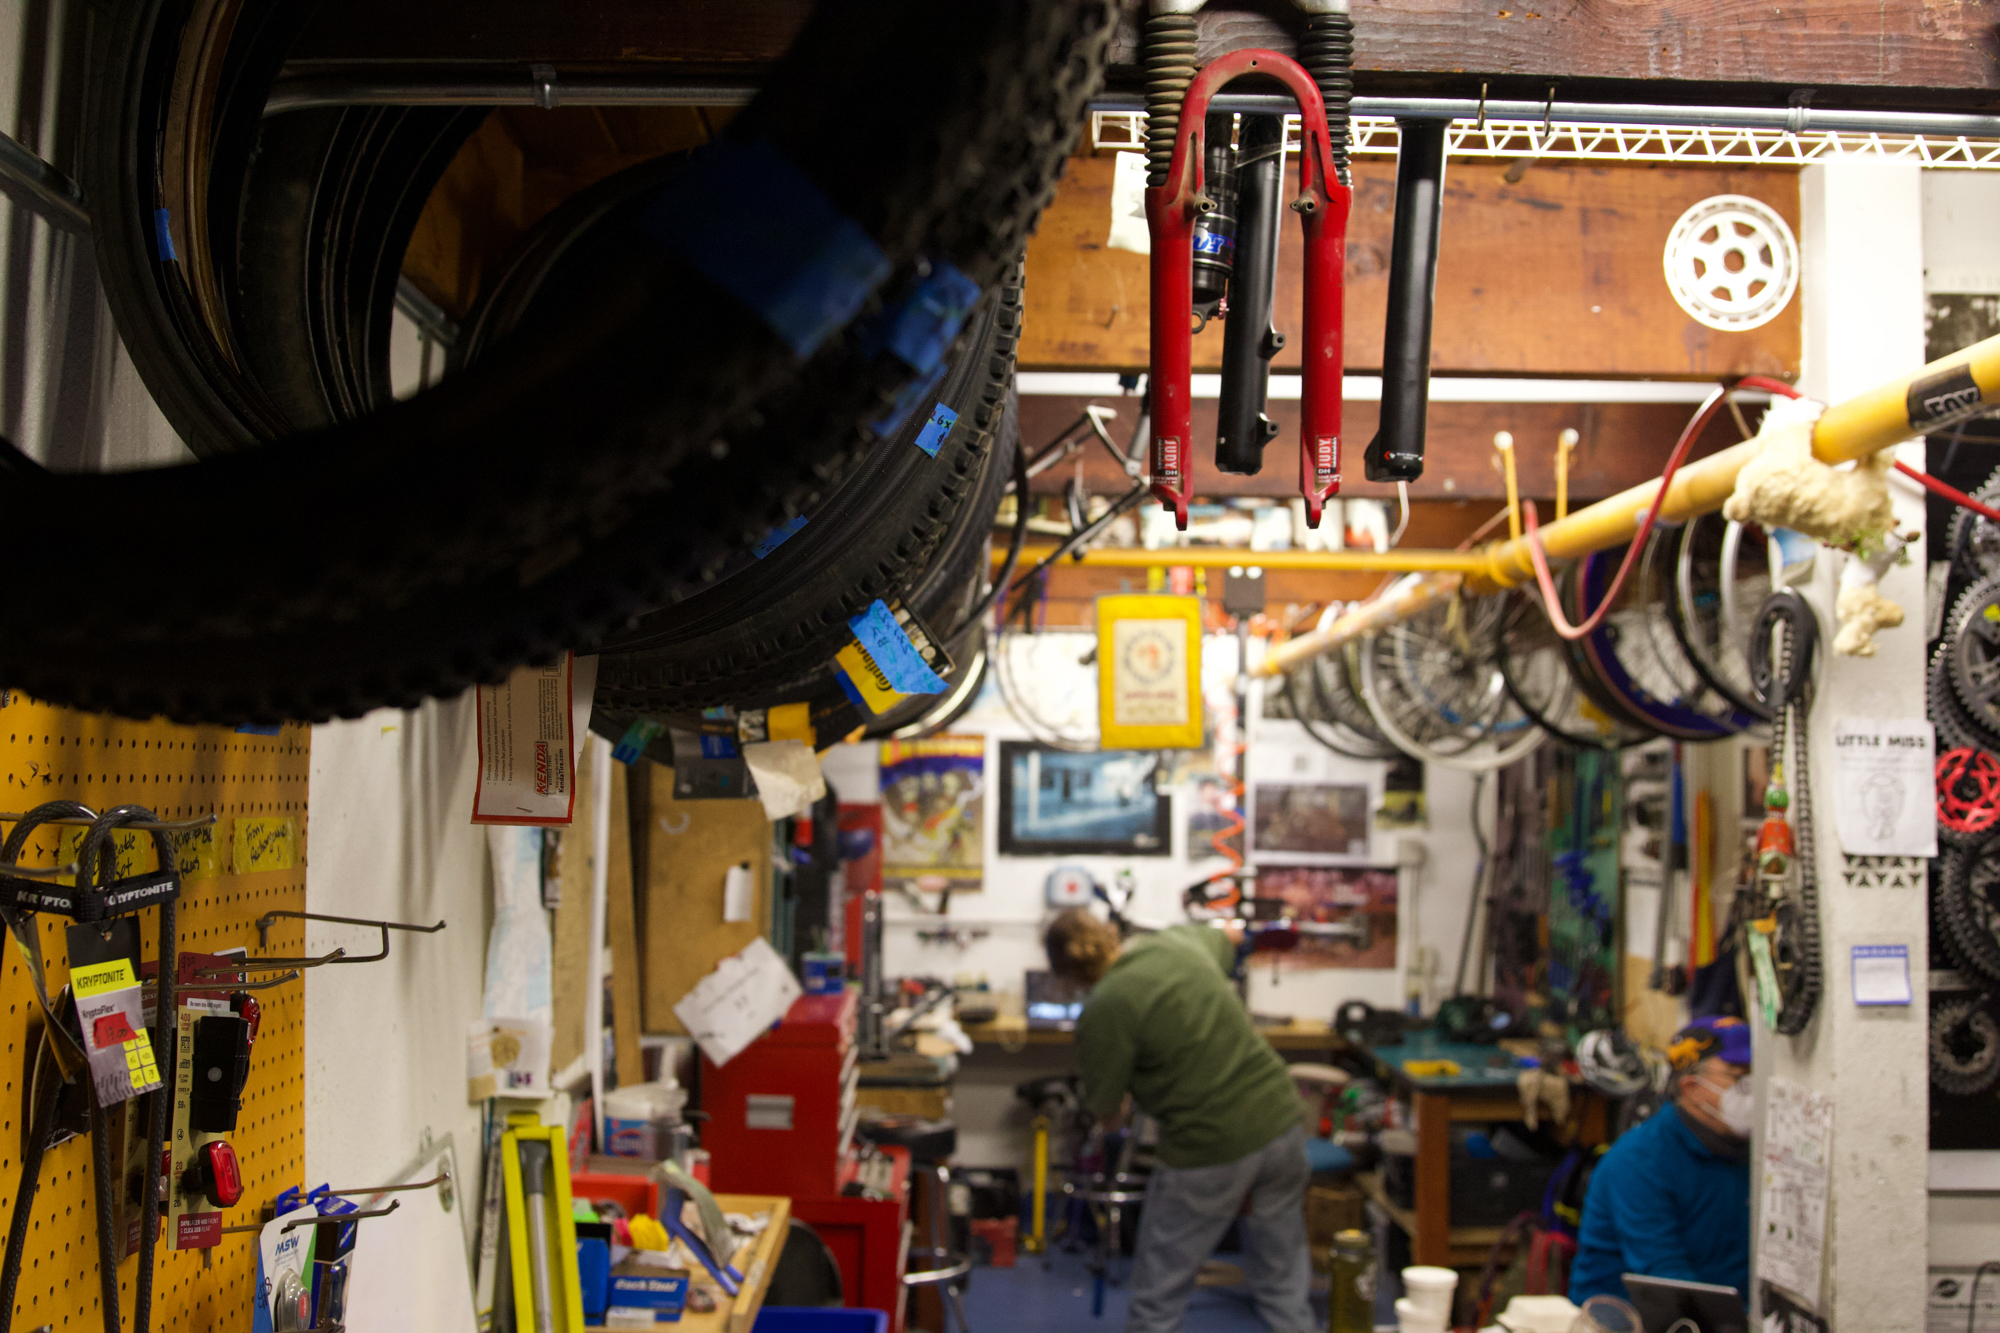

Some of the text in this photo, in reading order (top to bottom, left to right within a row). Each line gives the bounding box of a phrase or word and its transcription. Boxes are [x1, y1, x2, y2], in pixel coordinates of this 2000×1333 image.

[1164, 439, 1178, 469] JUDY
[1318, 438, 1332, 468] JUDY
[1836, 734, 1927, 748] LITTLE MISS
[536, 744, 546, 793] KENDA
[76, 970, 124, 990] KRYPTONITE
[181, 1013, 190, 1022] 400
[275, 1235, 300, 1256] MSW
